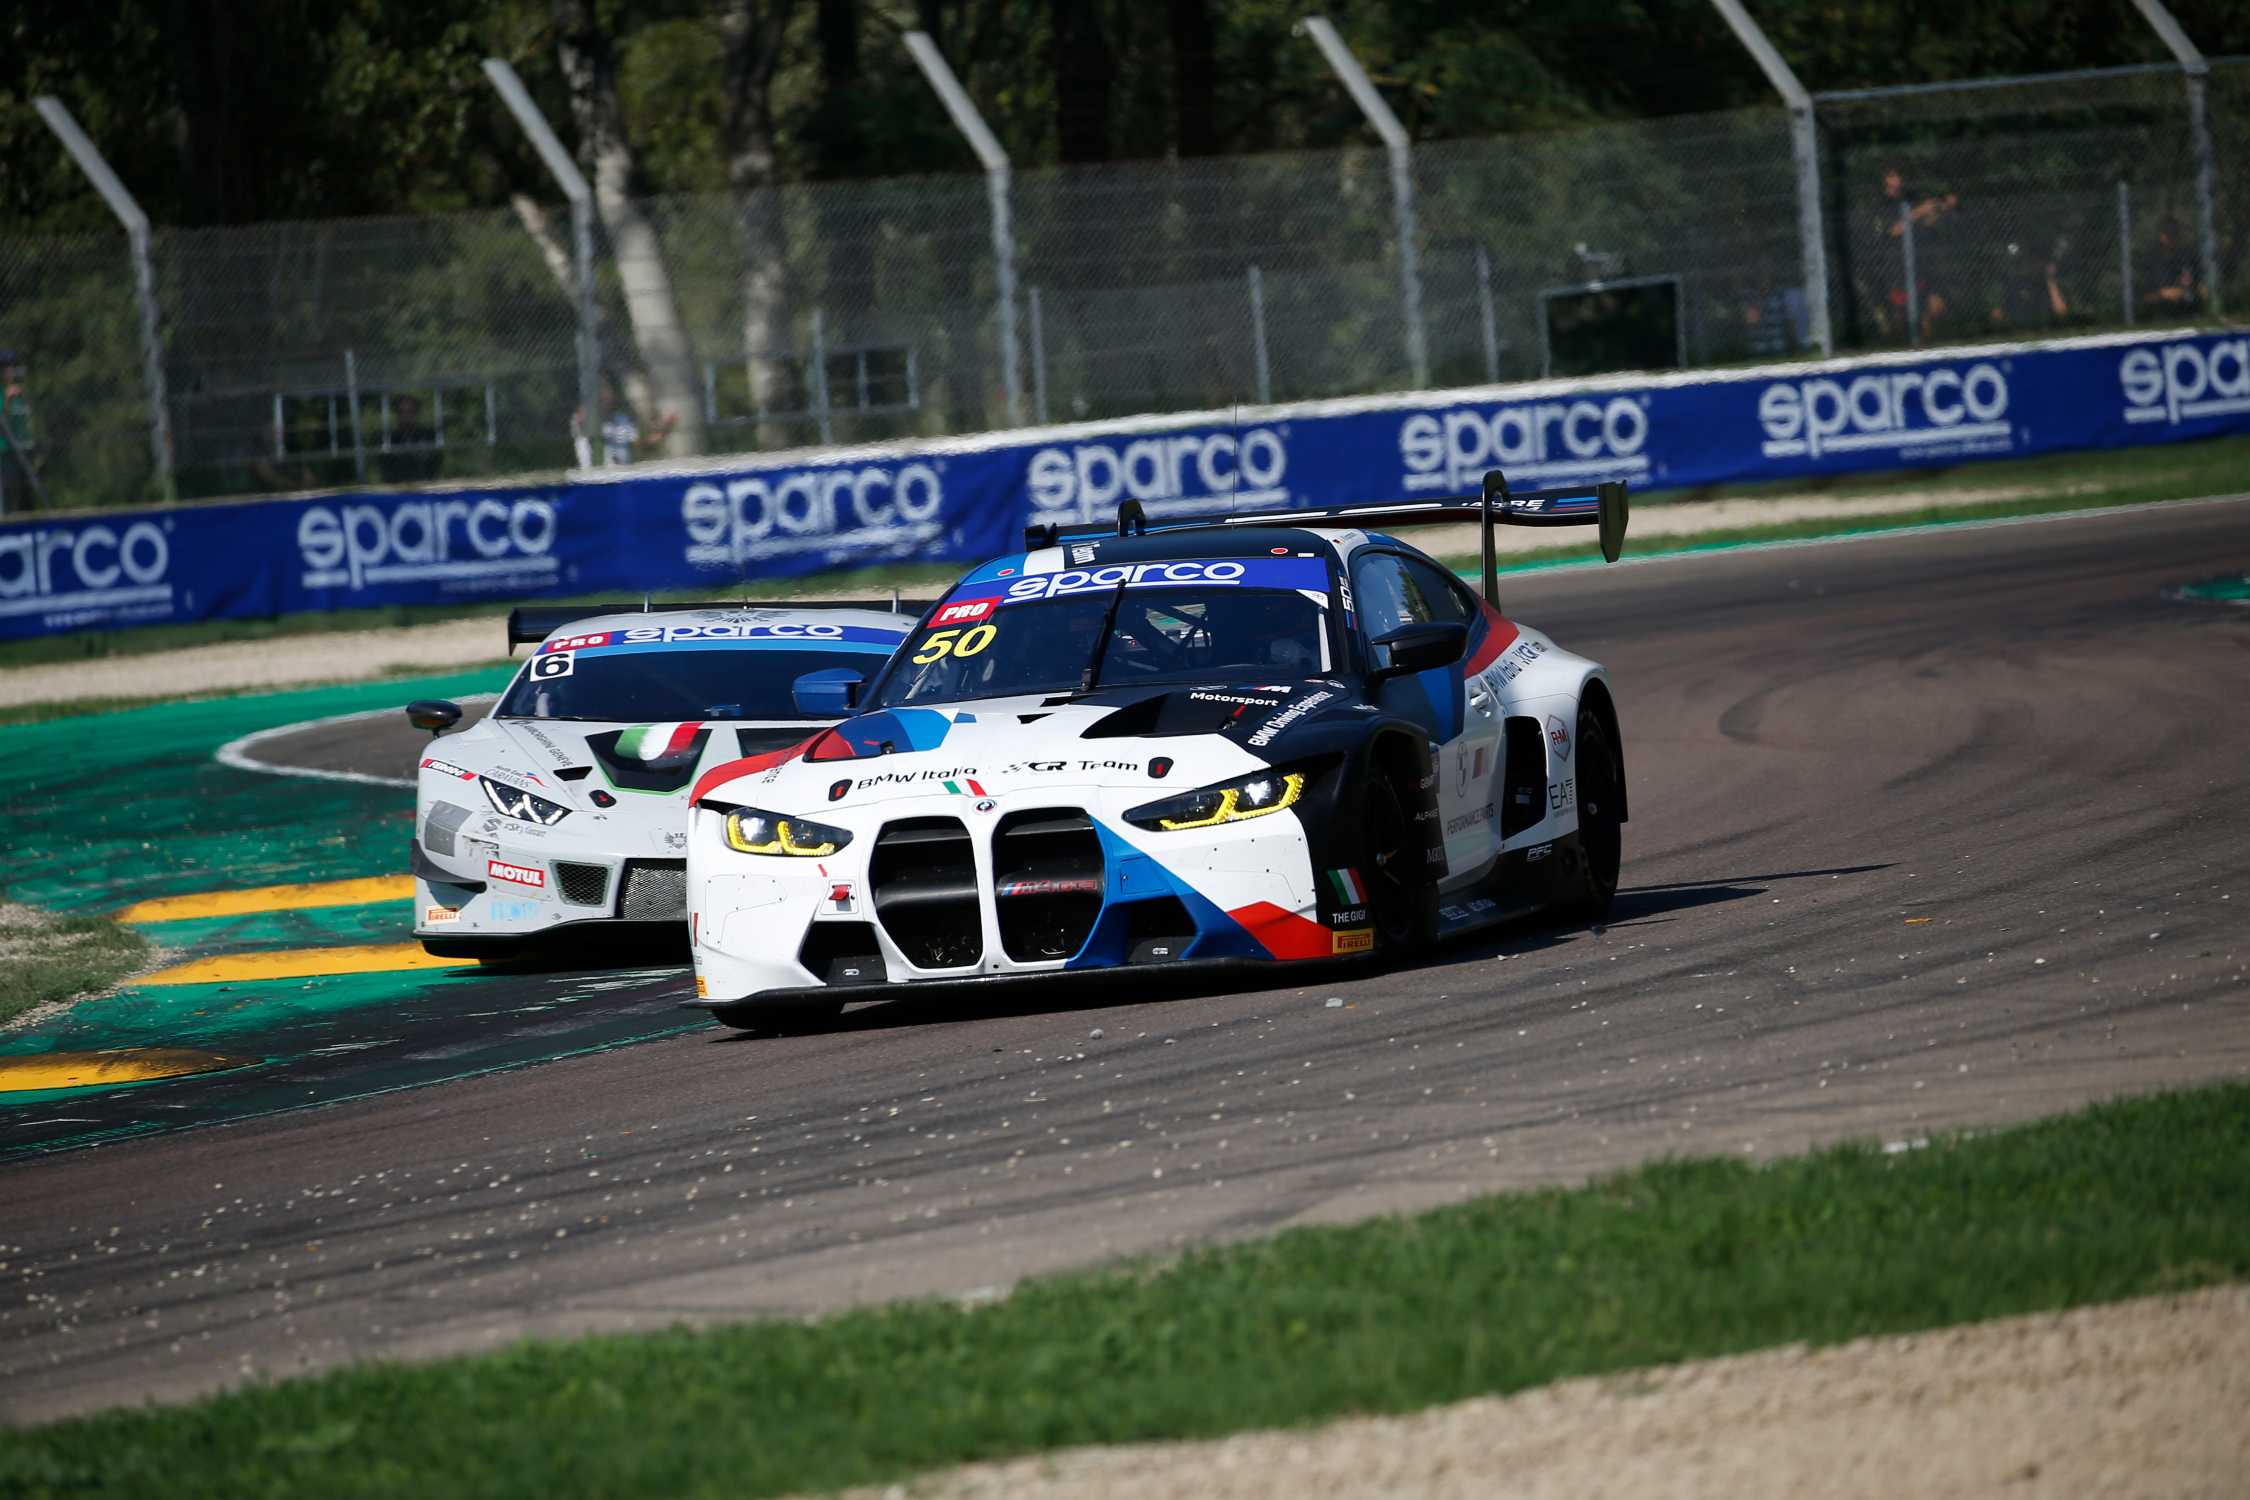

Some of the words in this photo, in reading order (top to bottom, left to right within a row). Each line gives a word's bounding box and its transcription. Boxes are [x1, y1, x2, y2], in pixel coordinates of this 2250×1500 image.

[1759, 363, 2009, 457] sparco
[1402, 397, 1649, 494] sparco
[1028, 428, 1288, 524] sparco
[682, 463, 941, 563] sparco
[299, 498, 557, 590] sparco
[1008, 562, 1246, 598] sparco
[939, 602, 989, 622] PRO
[554, 635, 604, 650] PRO
[624, 623, 843, 642] sparco
[912, 624, 998, 665] 50
[535, 653, 570, 680] 6
[1190, 692, 1279, 707] Motorsport
[1248, 725, 1280, 746] BMW
[428, 760, 467, 777] FERODO
[857, 772, 916, 790] BMW
[922, 766, 977, 781] Italia
[1077, 759, 1139, 771] Team
[490, 862, 542, 885] MOTUL
[1332, 911, 1350, 924] THE
[1337, 933, 1370, 950] PIRELLI
